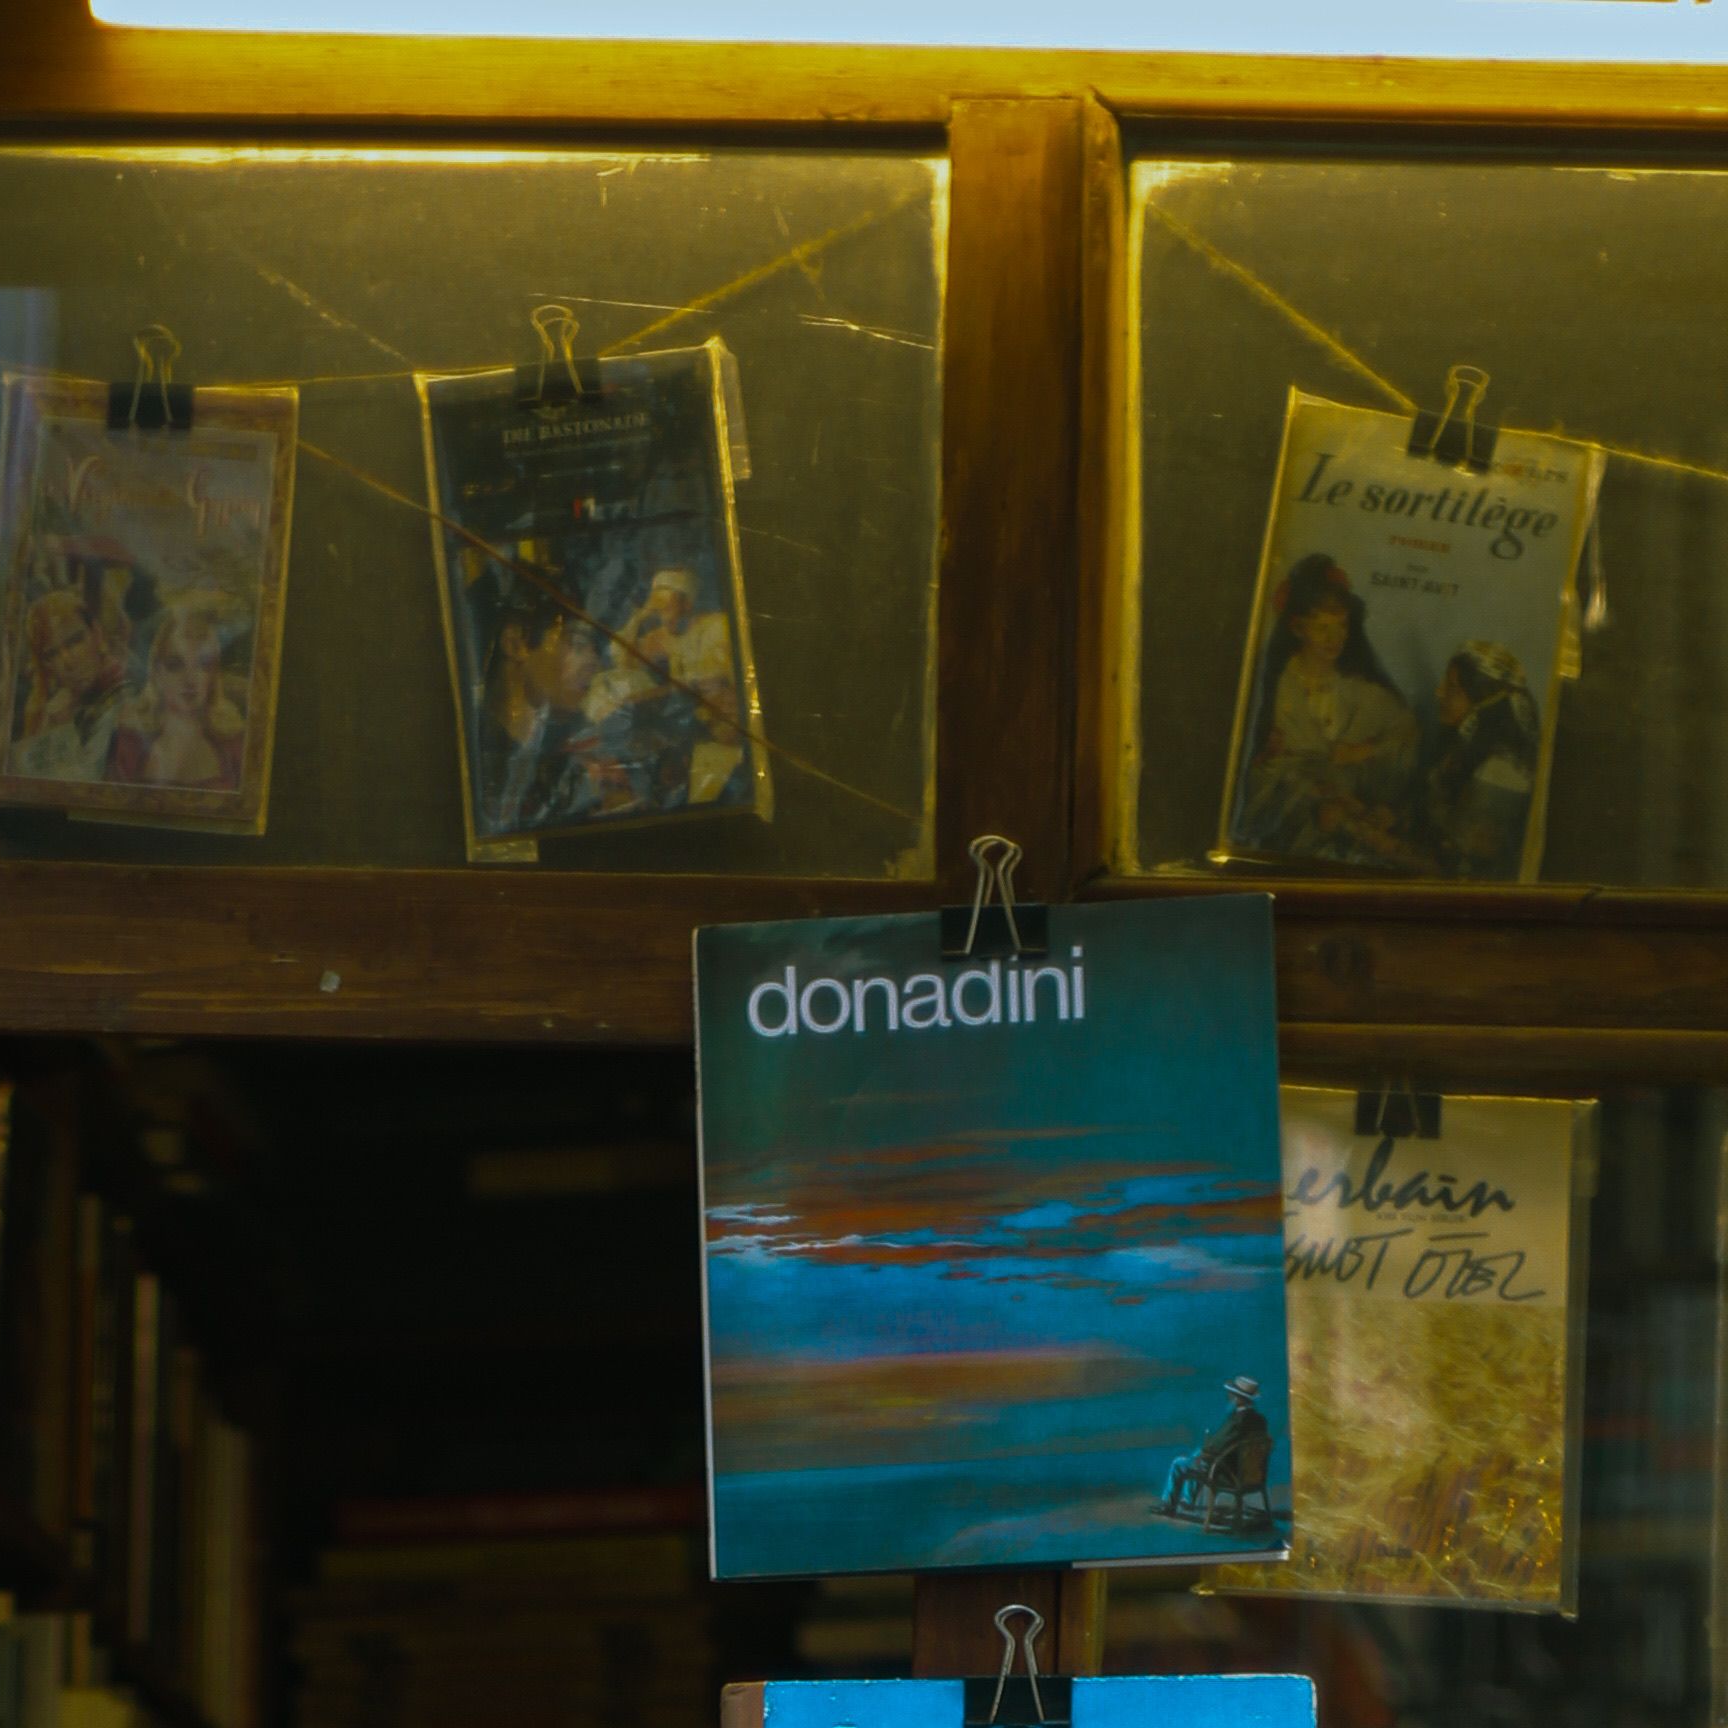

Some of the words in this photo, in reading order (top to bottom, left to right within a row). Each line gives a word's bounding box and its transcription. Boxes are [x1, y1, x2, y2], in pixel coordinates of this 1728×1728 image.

[1297, 453, 1354, 506] Le
[1360, 484, 1559, 561] sortilège
[747, 944, 1086, 1038] donadini
